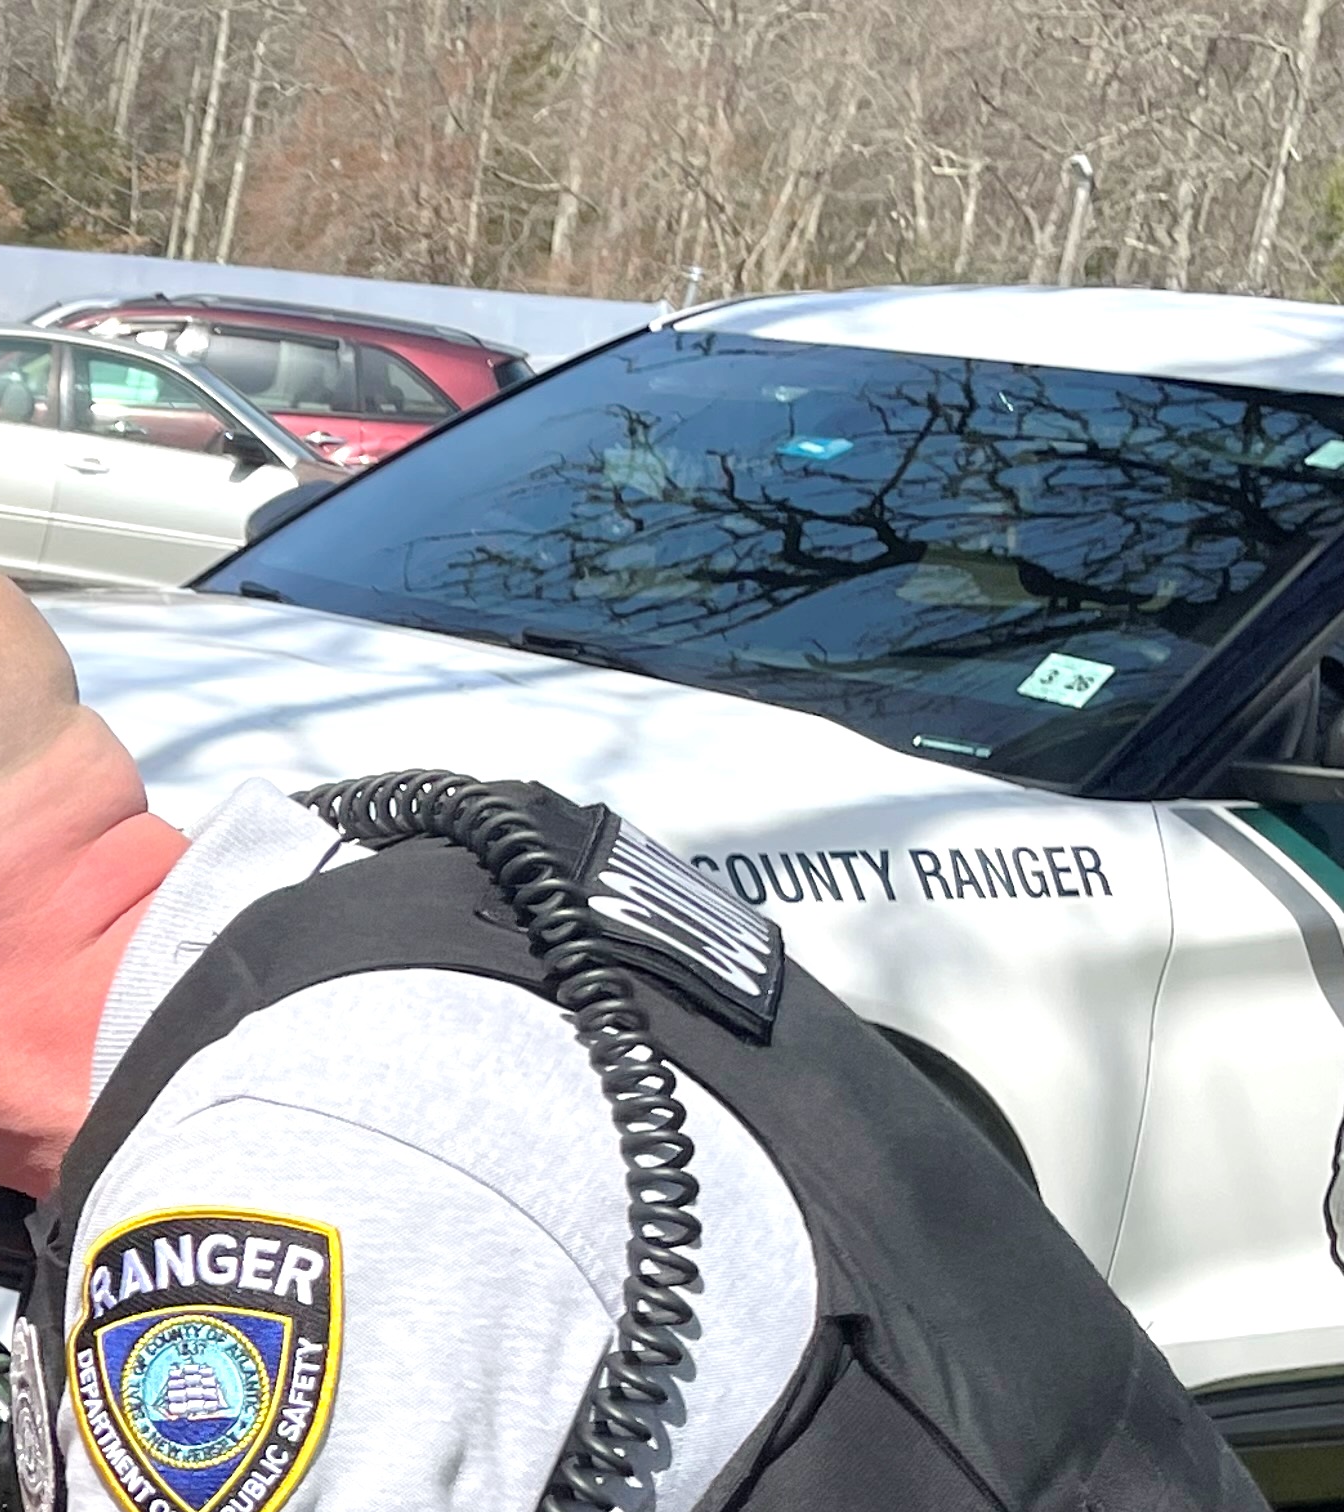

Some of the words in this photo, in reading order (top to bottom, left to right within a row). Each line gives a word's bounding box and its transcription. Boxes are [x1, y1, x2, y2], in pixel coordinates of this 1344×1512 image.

[907, 845, 1113, 902] RANGER
[90, 1232, 325, 1318] RANGER
[75, 1346, 155, 1503] DEPARTMENT
[277, 1336, 325, 1443] SAFETY
